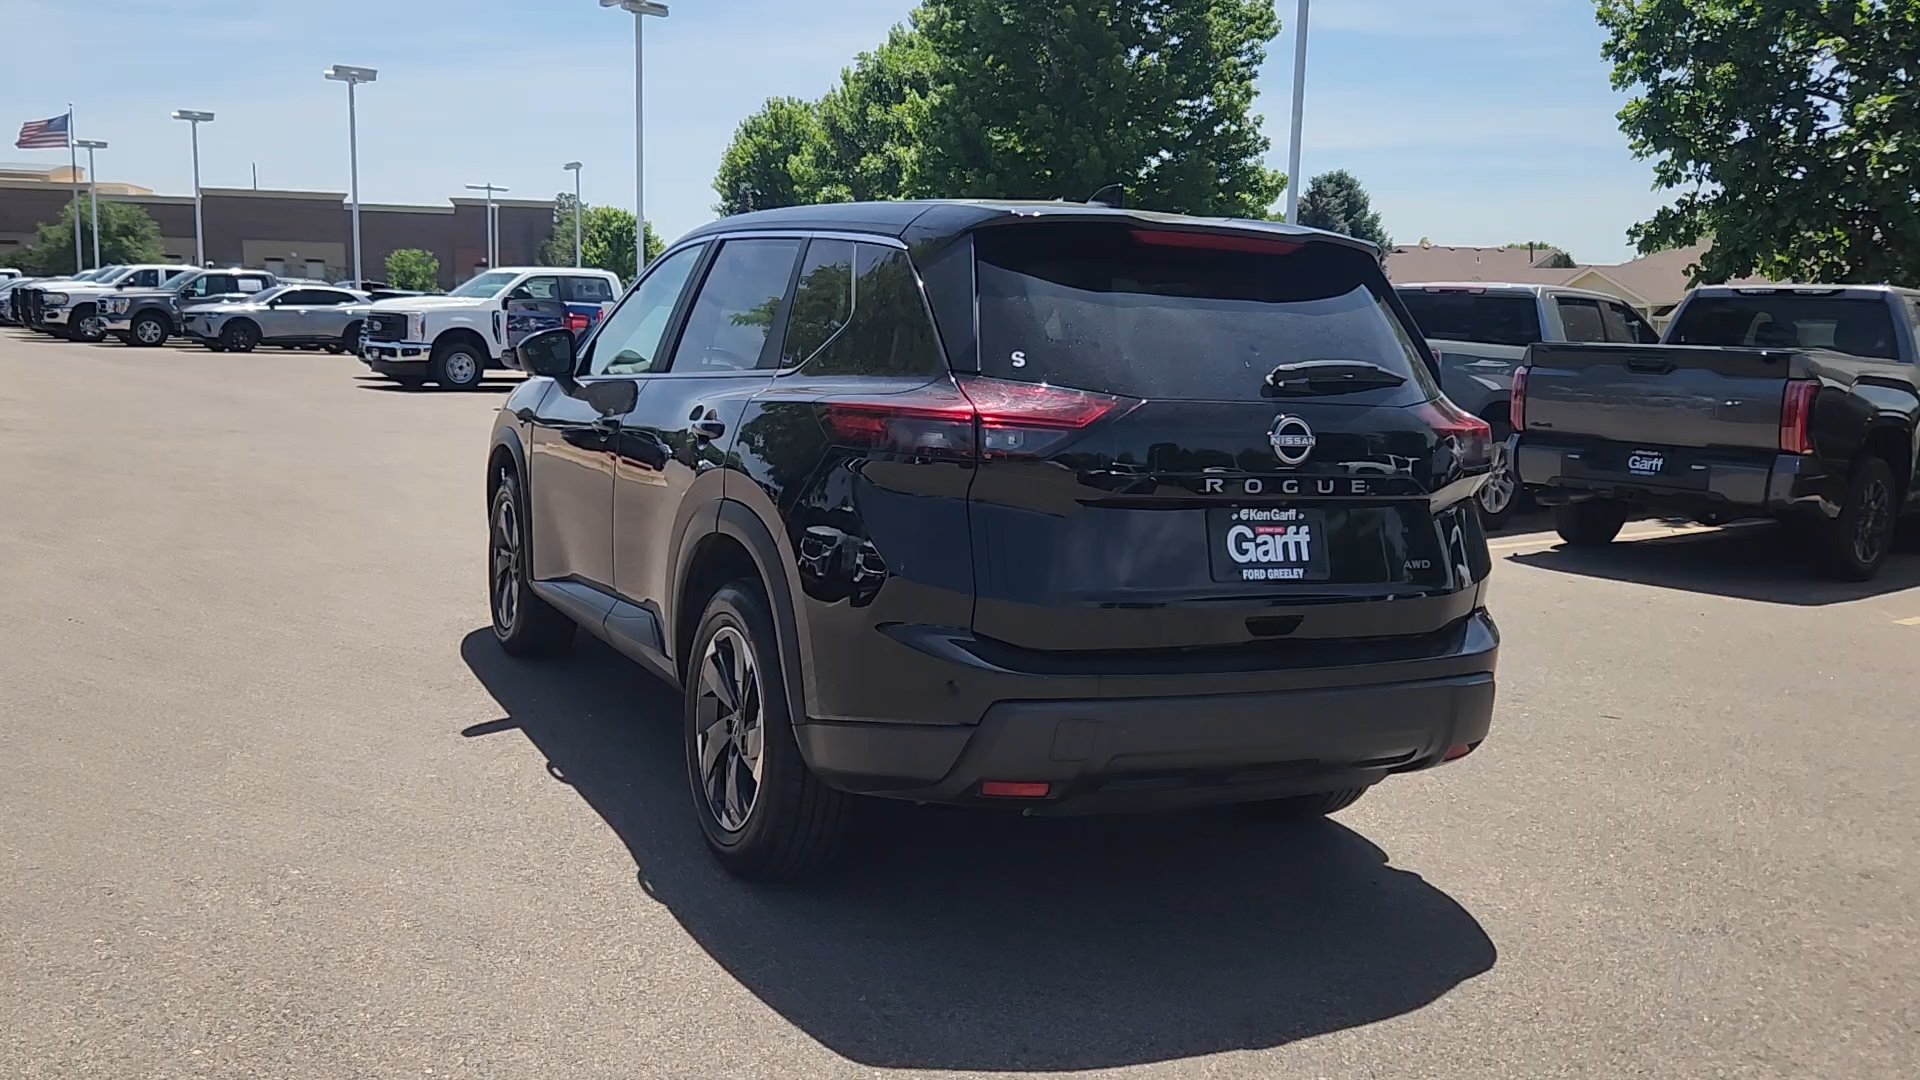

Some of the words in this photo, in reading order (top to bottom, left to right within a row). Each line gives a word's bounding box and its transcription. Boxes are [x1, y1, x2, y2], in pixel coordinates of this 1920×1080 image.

[1011, 351, 1026, 368] S
[1271, 436, 1316, 446] NISSAN
[1628, 456, 1664, 471] Garff
[1205, 478, 1366, 494] ROGUE
[1249, 508, 1270, 521] Ken
[1270, 508, 1297, 521] Garff
[1227, 525, 1310, 563] Garff
[1403, 559, 1431, 569] AWD
[1242, 569, 1266, 580] FORD
[1267, 568, 1304, 579] GREELEY
